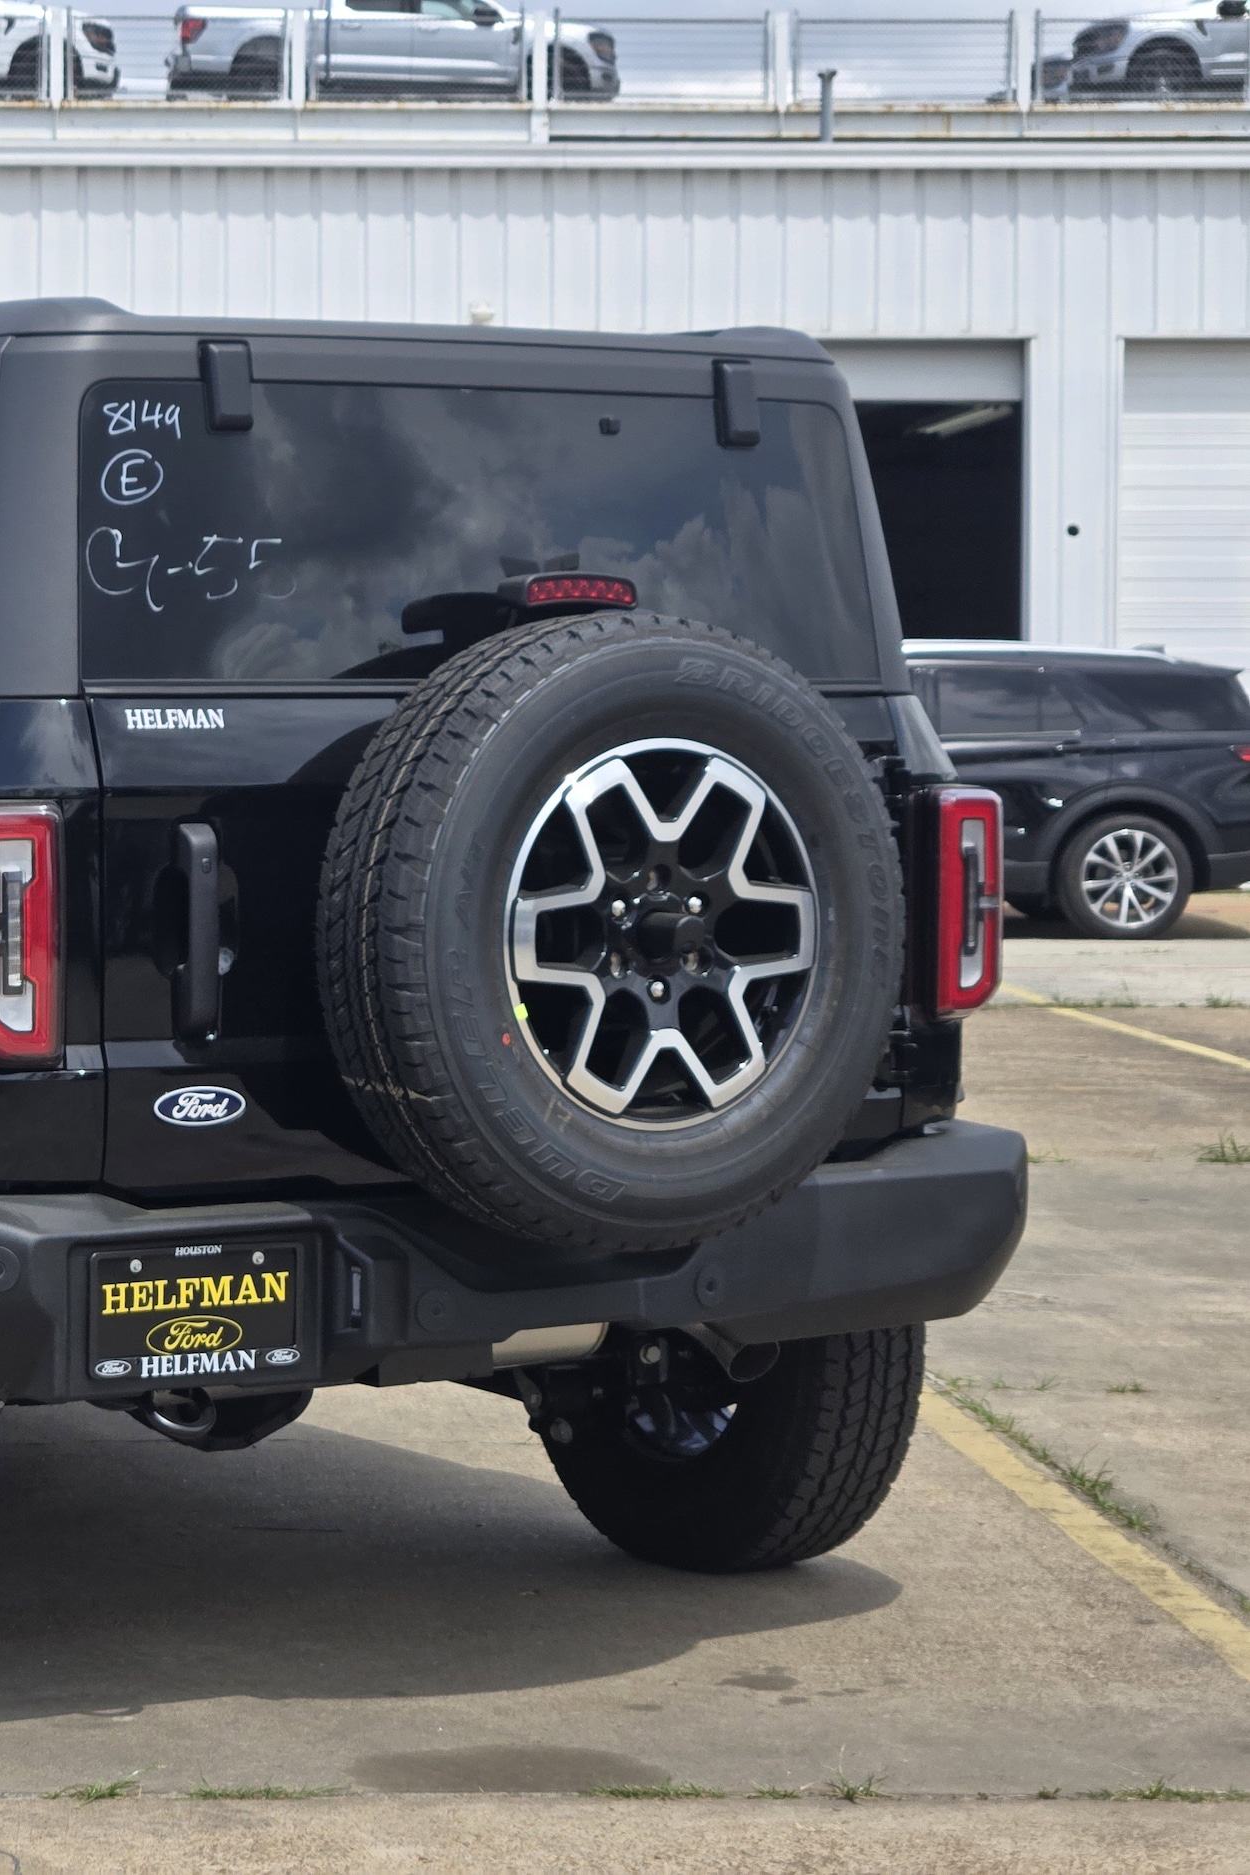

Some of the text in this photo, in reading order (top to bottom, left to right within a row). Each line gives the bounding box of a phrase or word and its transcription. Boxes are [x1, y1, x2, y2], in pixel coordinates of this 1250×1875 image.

[124, 708, 225, 729] HELFMAN
[673, 655, 892, 982] BRIDGESTONE
[446, 947, 630, 1203] DUELER
[172, 1092, 229, 1119] Ford
[175, 1244, 222, 1257] HOUSTON
[102, 1271, 290, 1315] HELFMAN
[164, 1321, 224, 1351] Ford
[140, 1349, 257, 1378] HELFMAN
